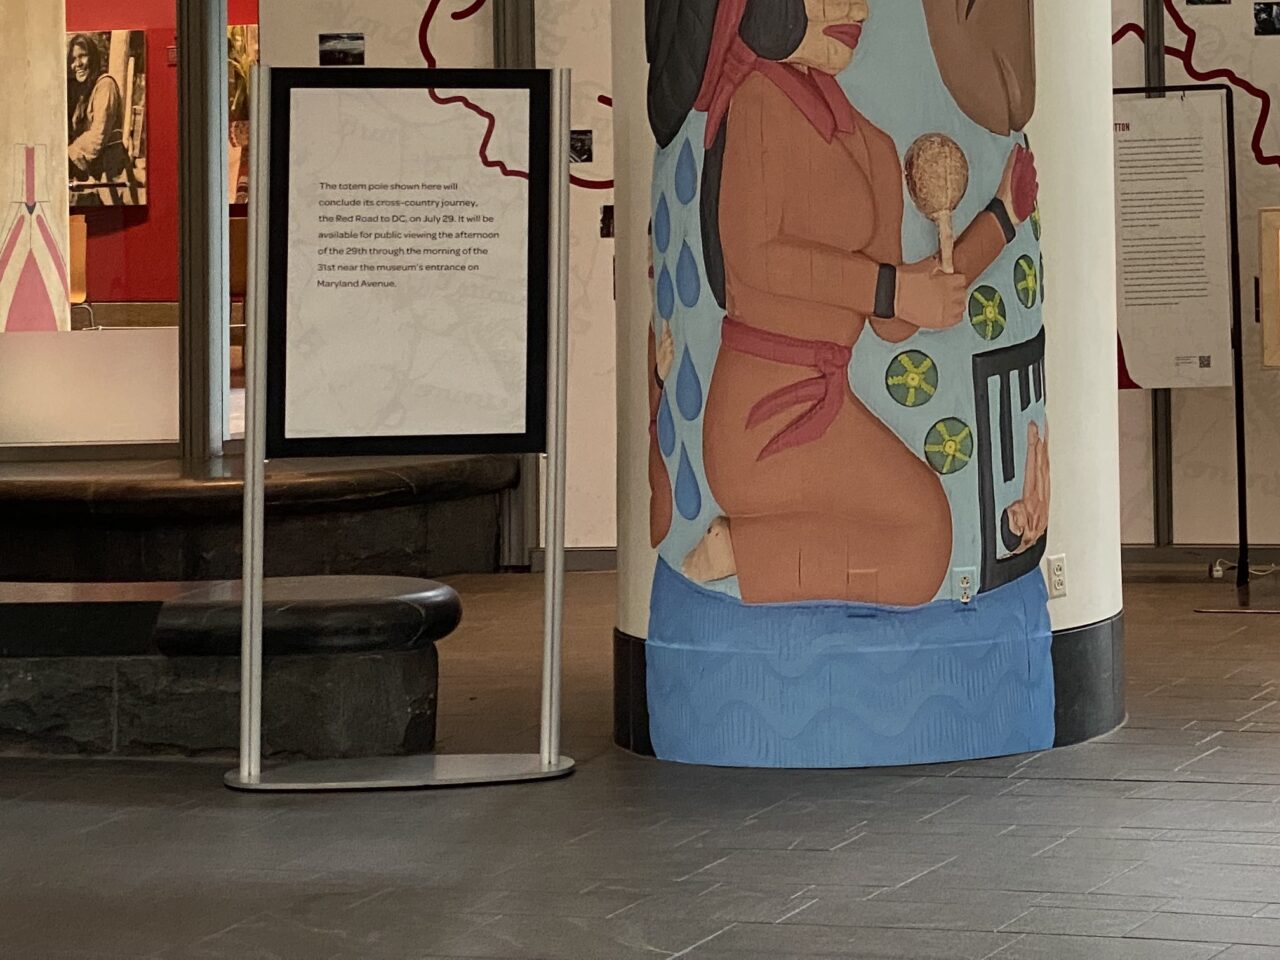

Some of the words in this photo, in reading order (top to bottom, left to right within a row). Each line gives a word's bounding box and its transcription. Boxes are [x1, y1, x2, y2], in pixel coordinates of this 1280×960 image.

[319, 182, 337, 190] The
[368, 183, 389, 192] pole
[422, 182, 442, 190] here
[443, 182, 458, 190] will
[318, 198, 361, 206] conclude
[376, 200, 440, 208] cross-country
[335, 214, 354, 222] Red
[355, 214, 379, 222] Road
[423, 215, 441, 224] July
[318, 230, 359, 239] available
[360, 230, 373, 239] for
[374, 230, 402, 240] public
[403, 230, 437, 240] viewing
[438, 231, 453, 239] the
[454, 230, 500, 239] afternoon
[318, 246, 328, 255] of
[329, 247, 344, 255] the
[346, 247, 367, 255] 29th
[369, 246, 405, 257] through
[423, 248, 461, 256] morning
[462, 246, 472, 255] of
[318, 263, 335, 271] 31st
[360, 263, 375, 271] the
[317, 279, 359, 288] Maryland
